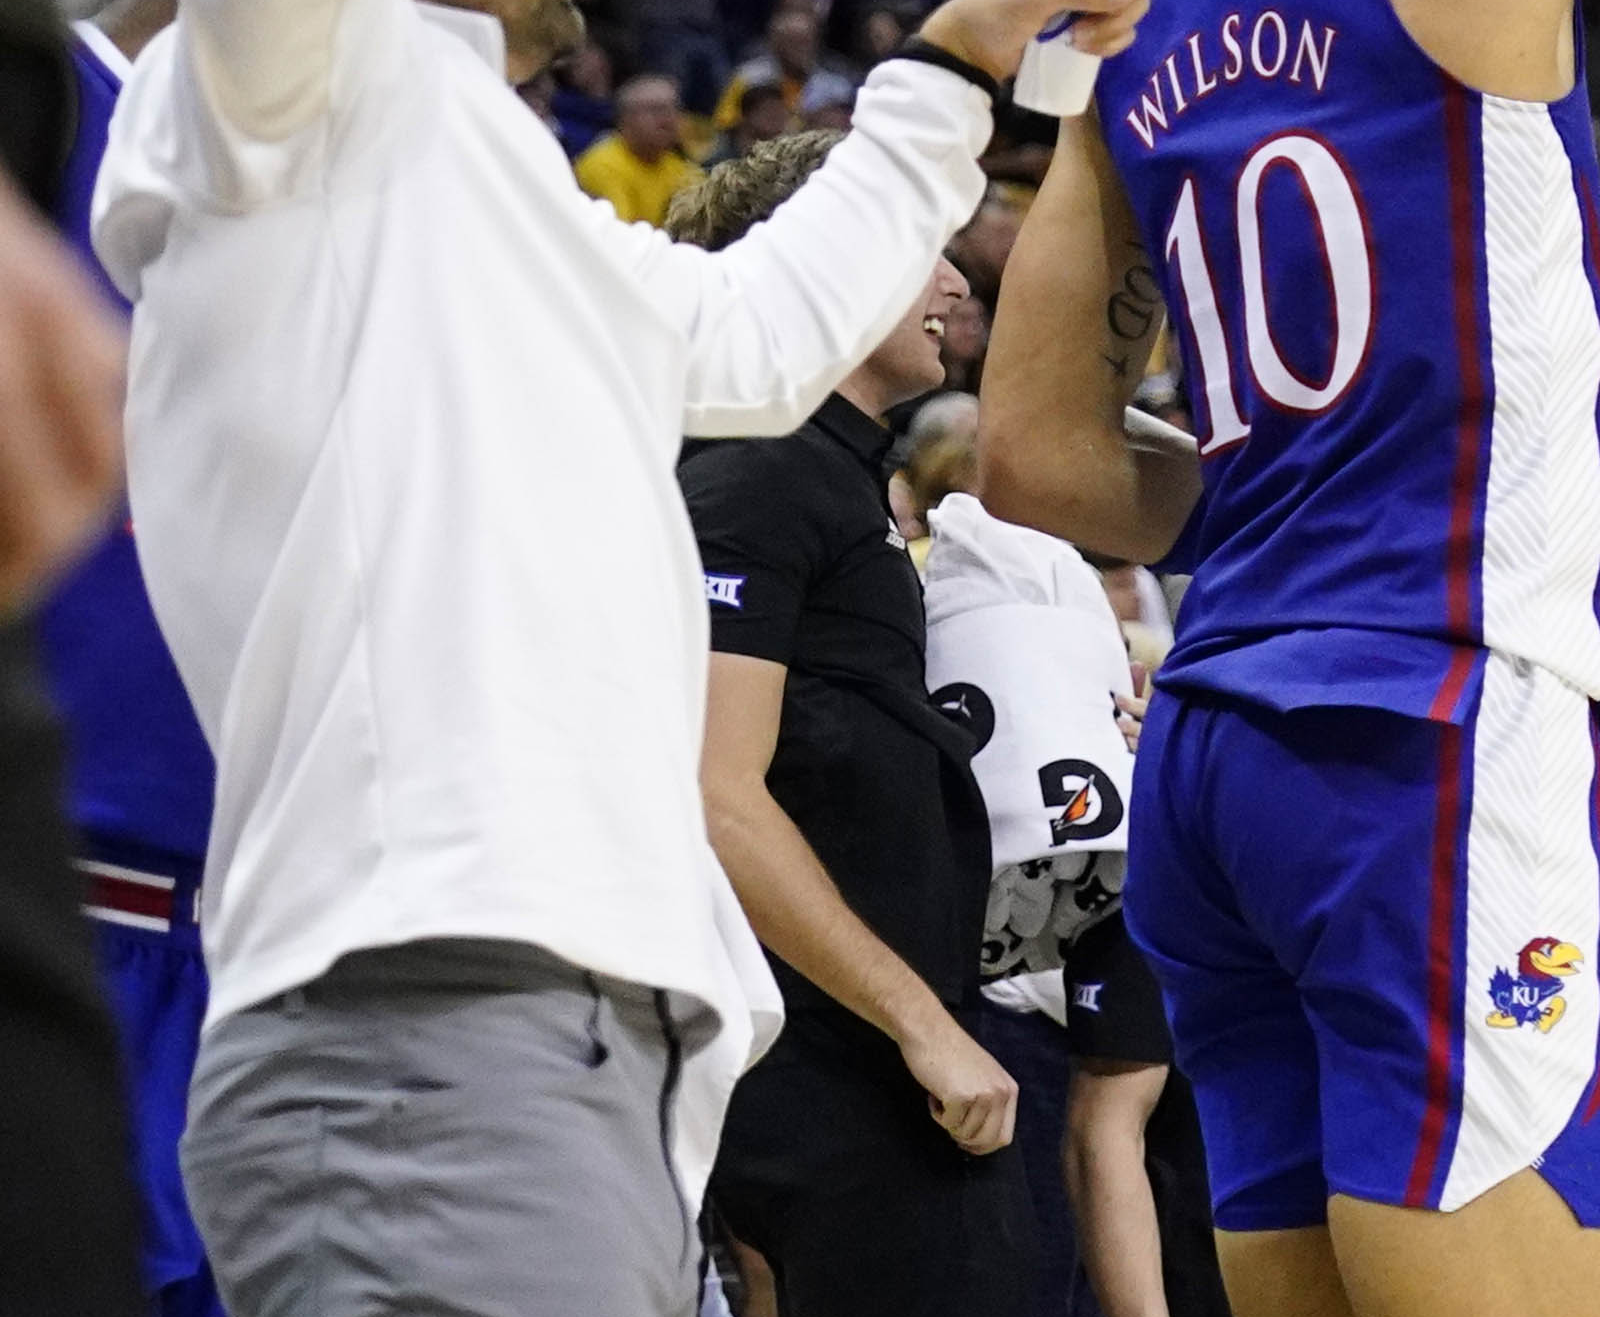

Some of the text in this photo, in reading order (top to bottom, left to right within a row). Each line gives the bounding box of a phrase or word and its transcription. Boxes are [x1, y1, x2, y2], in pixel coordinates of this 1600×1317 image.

[1126, 10, 1336, 151] WILSON
[1164, 128, 1376, 459] 10
[1511, 986, 1540, 1008] KU
